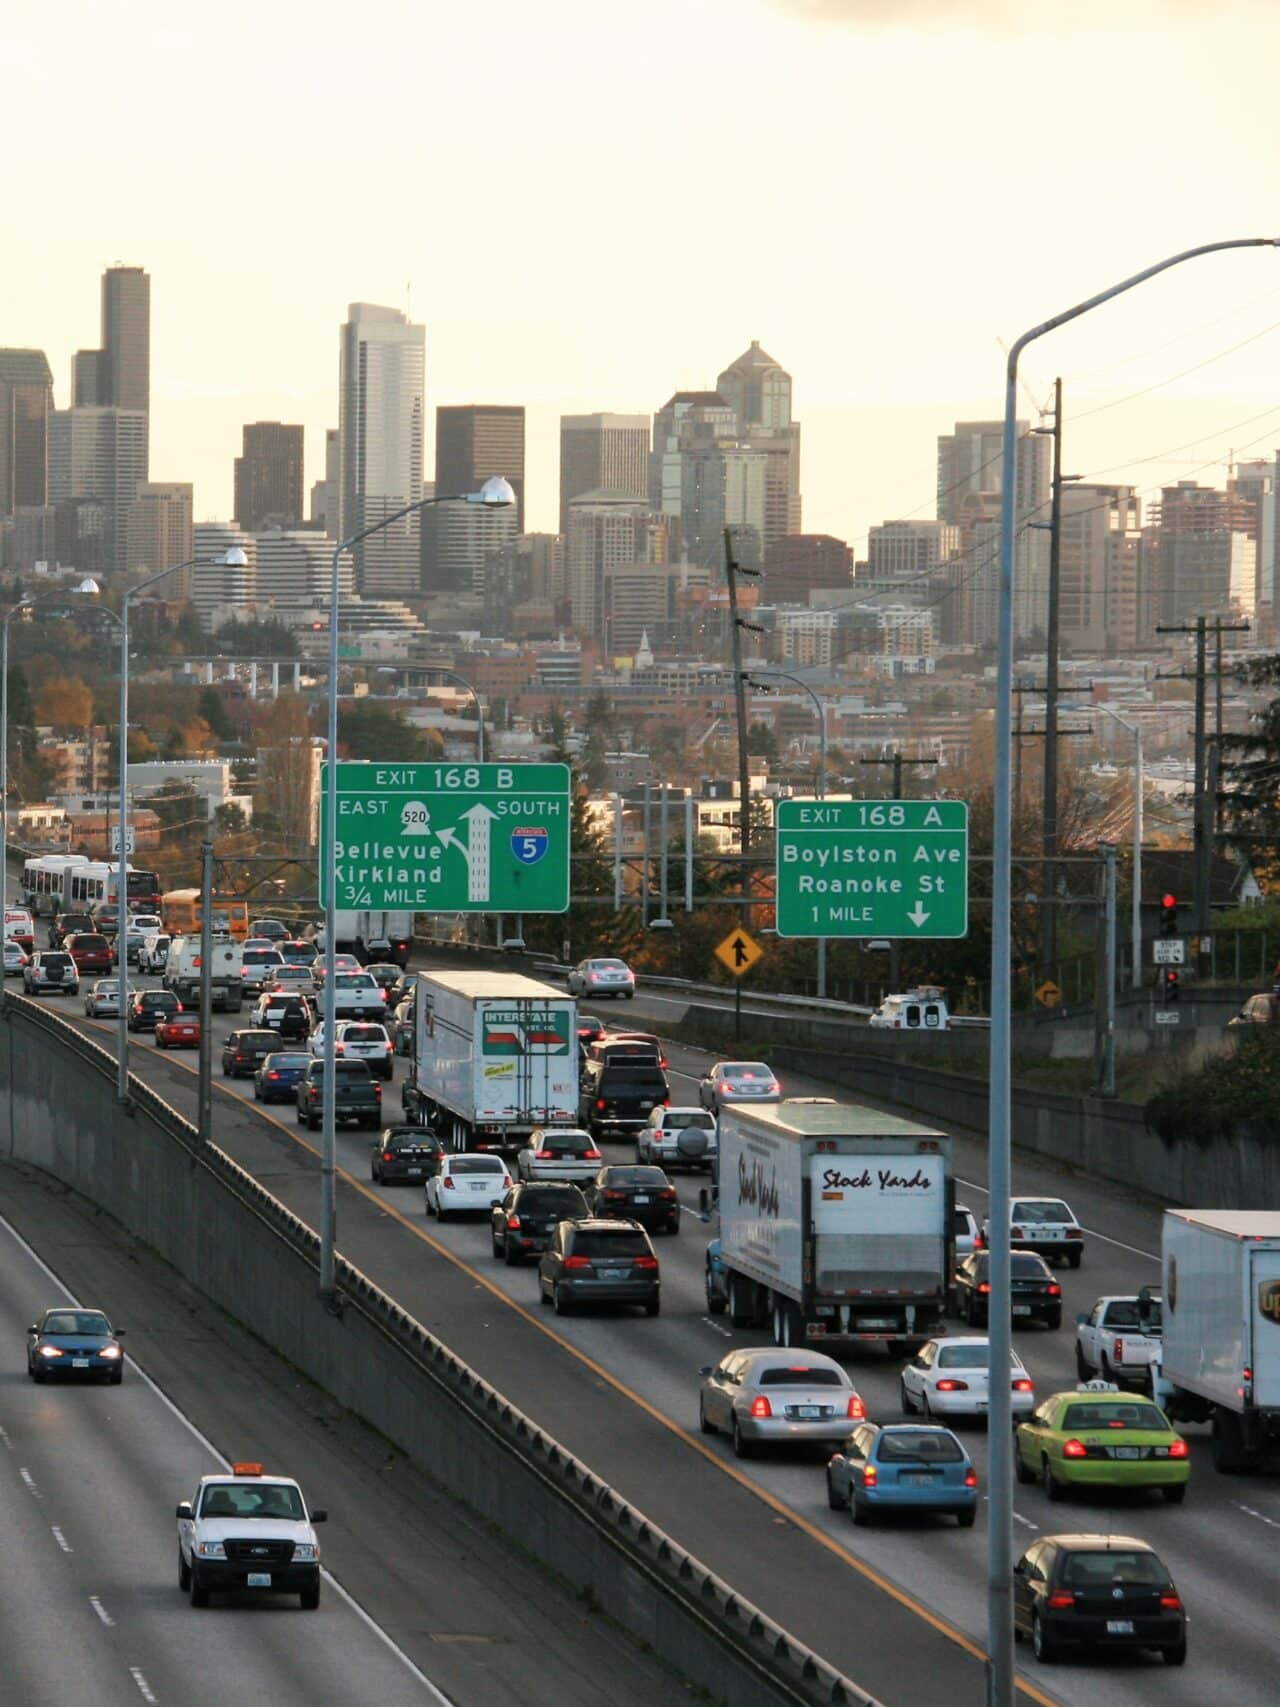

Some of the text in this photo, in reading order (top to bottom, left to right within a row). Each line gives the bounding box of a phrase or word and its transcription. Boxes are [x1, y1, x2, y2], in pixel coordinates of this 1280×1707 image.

[376, 768, 513, 788] EXIT 168 B
[339, 801, 388, 815] EAST
[404, 810, 426, 823] 520
[496, 801, 560, 815] SOUTH
[800, 806, 943, 826] EXIT 168 A
[335, 841, 442, 859] Bellevue
[523, 838, 537, 858] 5
[783, 845, 960, 867] Boylston Ave
[335, 865, 442, 883] Kirkland
[799, 876, 945, 893] Roanoke St
[383, 889, 427, 903] MILE
[812, 906, 873, 922] 1 MILE
[485, 1013, 557, 1022] INTERSATE
[823, 1169, 932, 1190] Stock Yards
